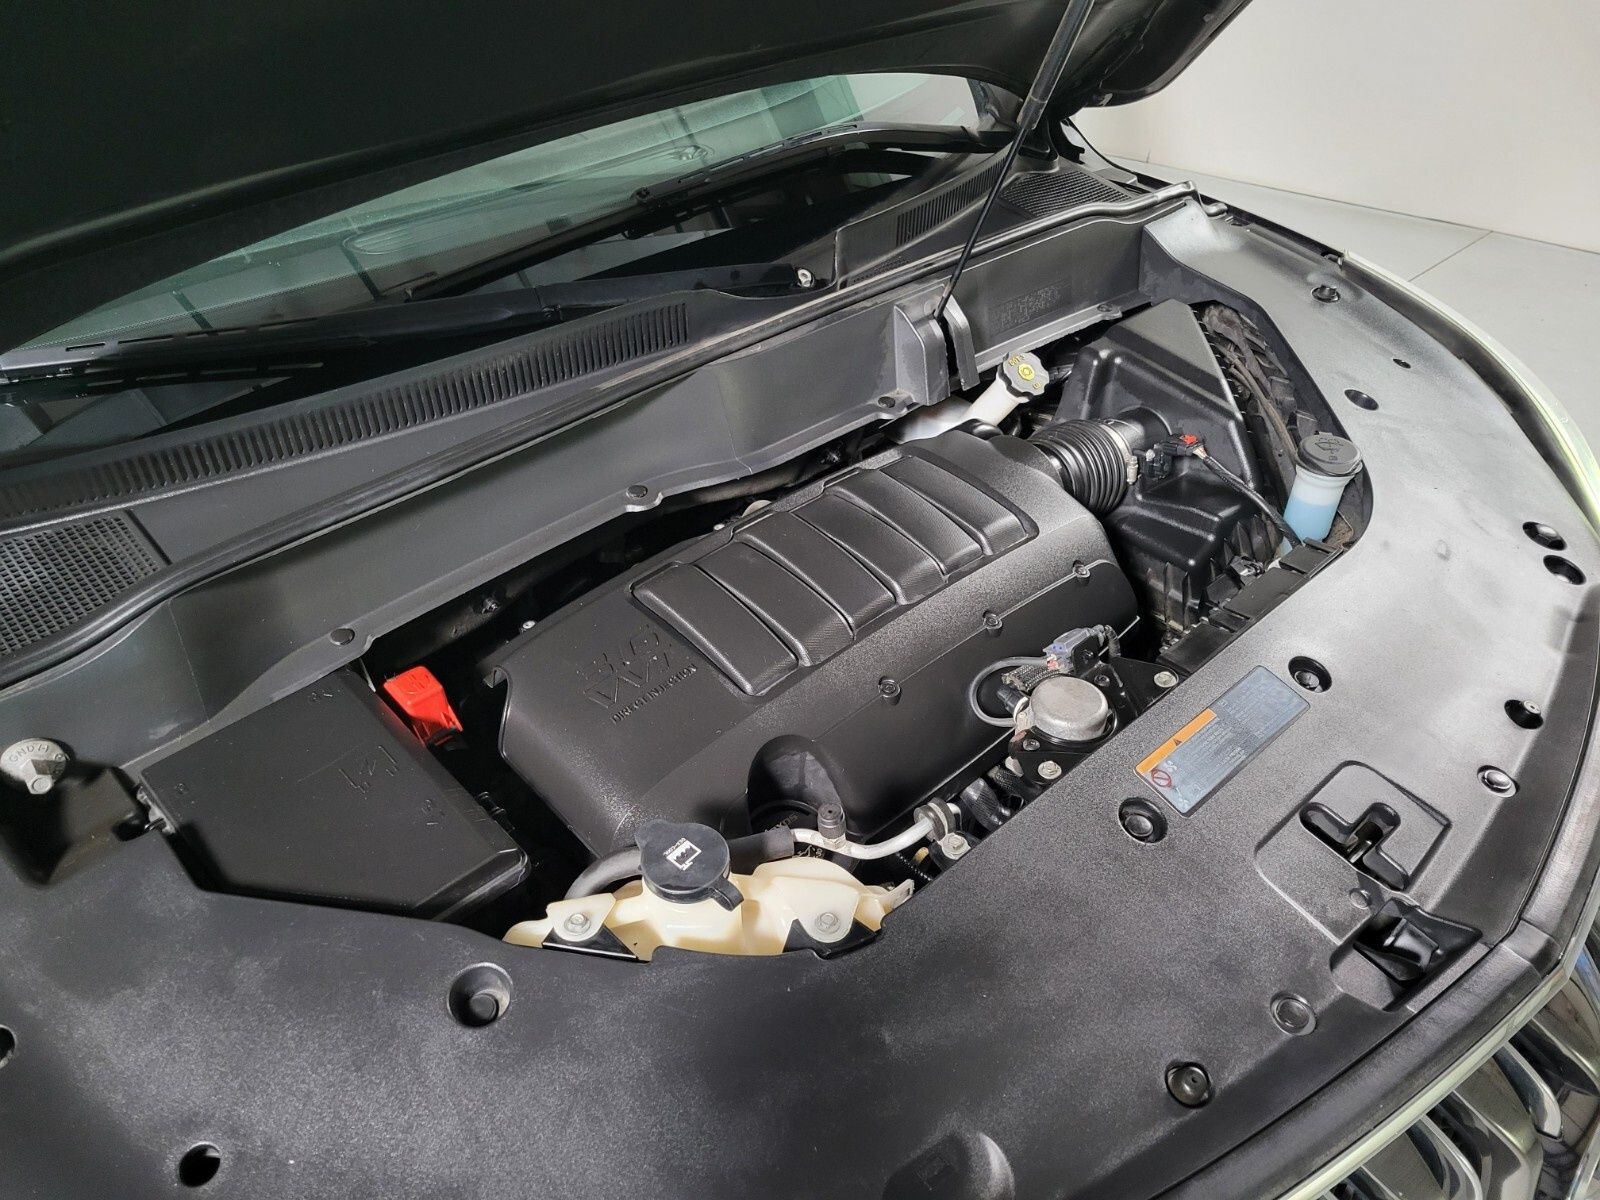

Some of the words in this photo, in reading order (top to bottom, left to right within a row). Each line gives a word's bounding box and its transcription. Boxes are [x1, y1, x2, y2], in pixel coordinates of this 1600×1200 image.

[610, 696, 648, 725] DIRECT
[646, 663, 698, 701] INJECTION
[9, 744, 35, 762] GND
